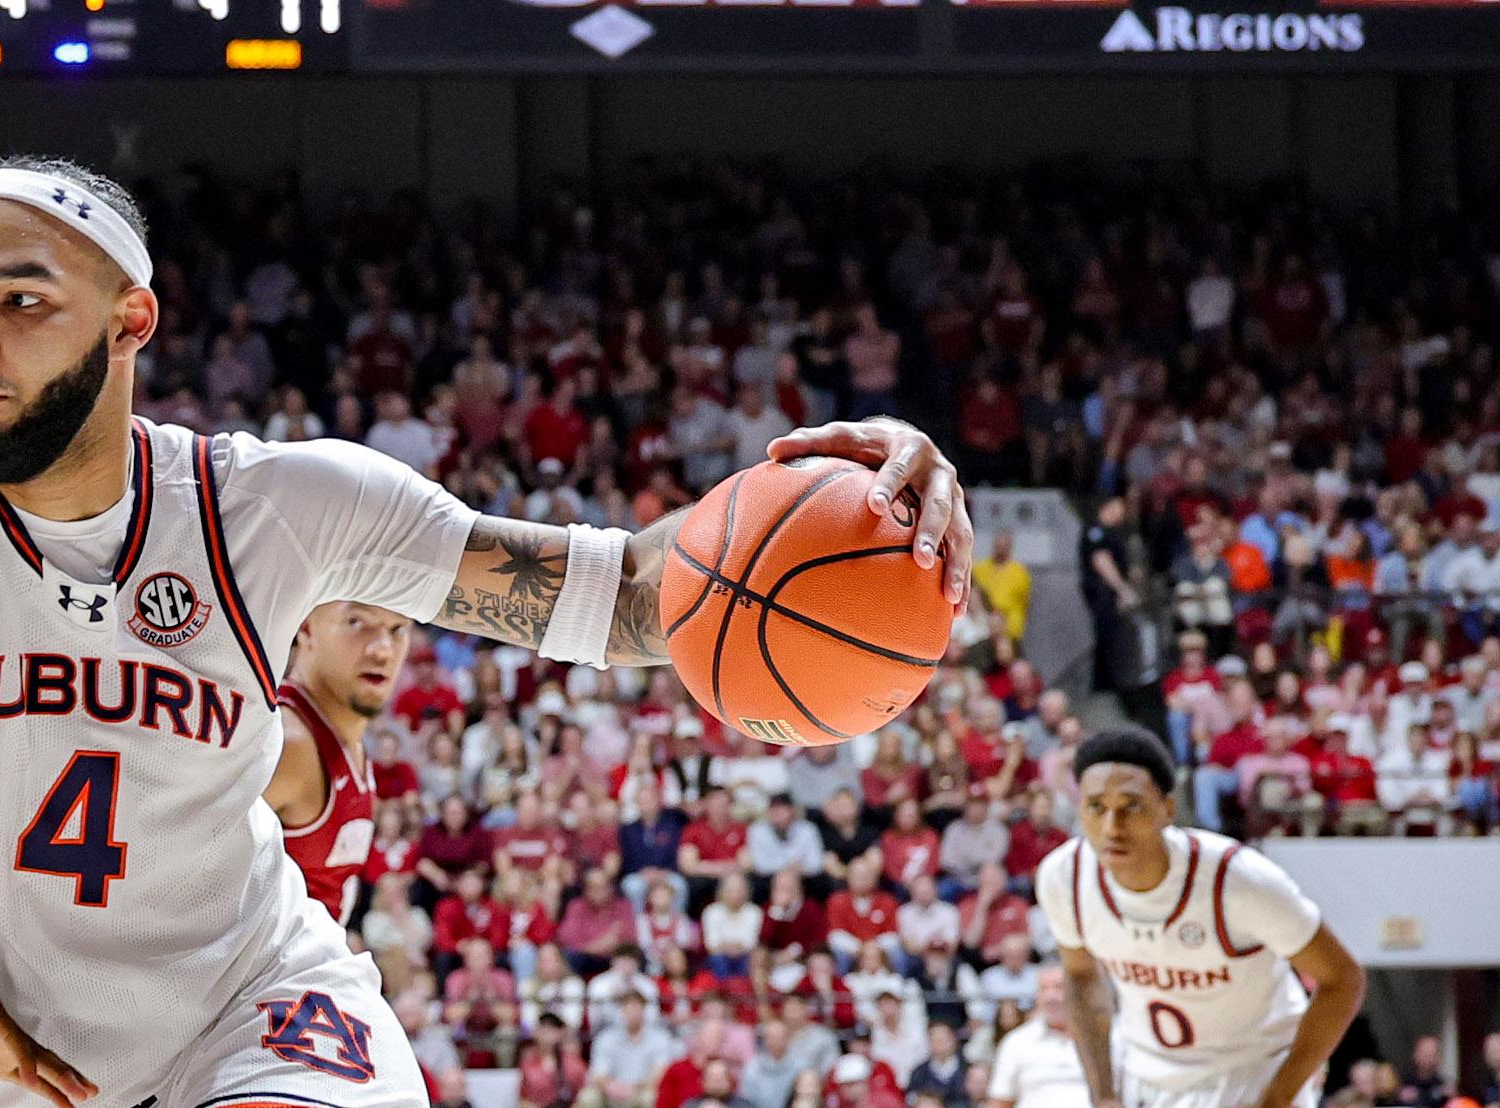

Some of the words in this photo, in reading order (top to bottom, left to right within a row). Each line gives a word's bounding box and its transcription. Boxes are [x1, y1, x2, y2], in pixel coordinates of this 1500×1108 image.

[1155, 6, 1365, 51] REGIONS
[140, 577, 193, 628] SEC
[140, 618, 203, 645] GRADUATE
[13, 749, 128, 908] 4
[1147, 1000, 1195, 1048] 0
